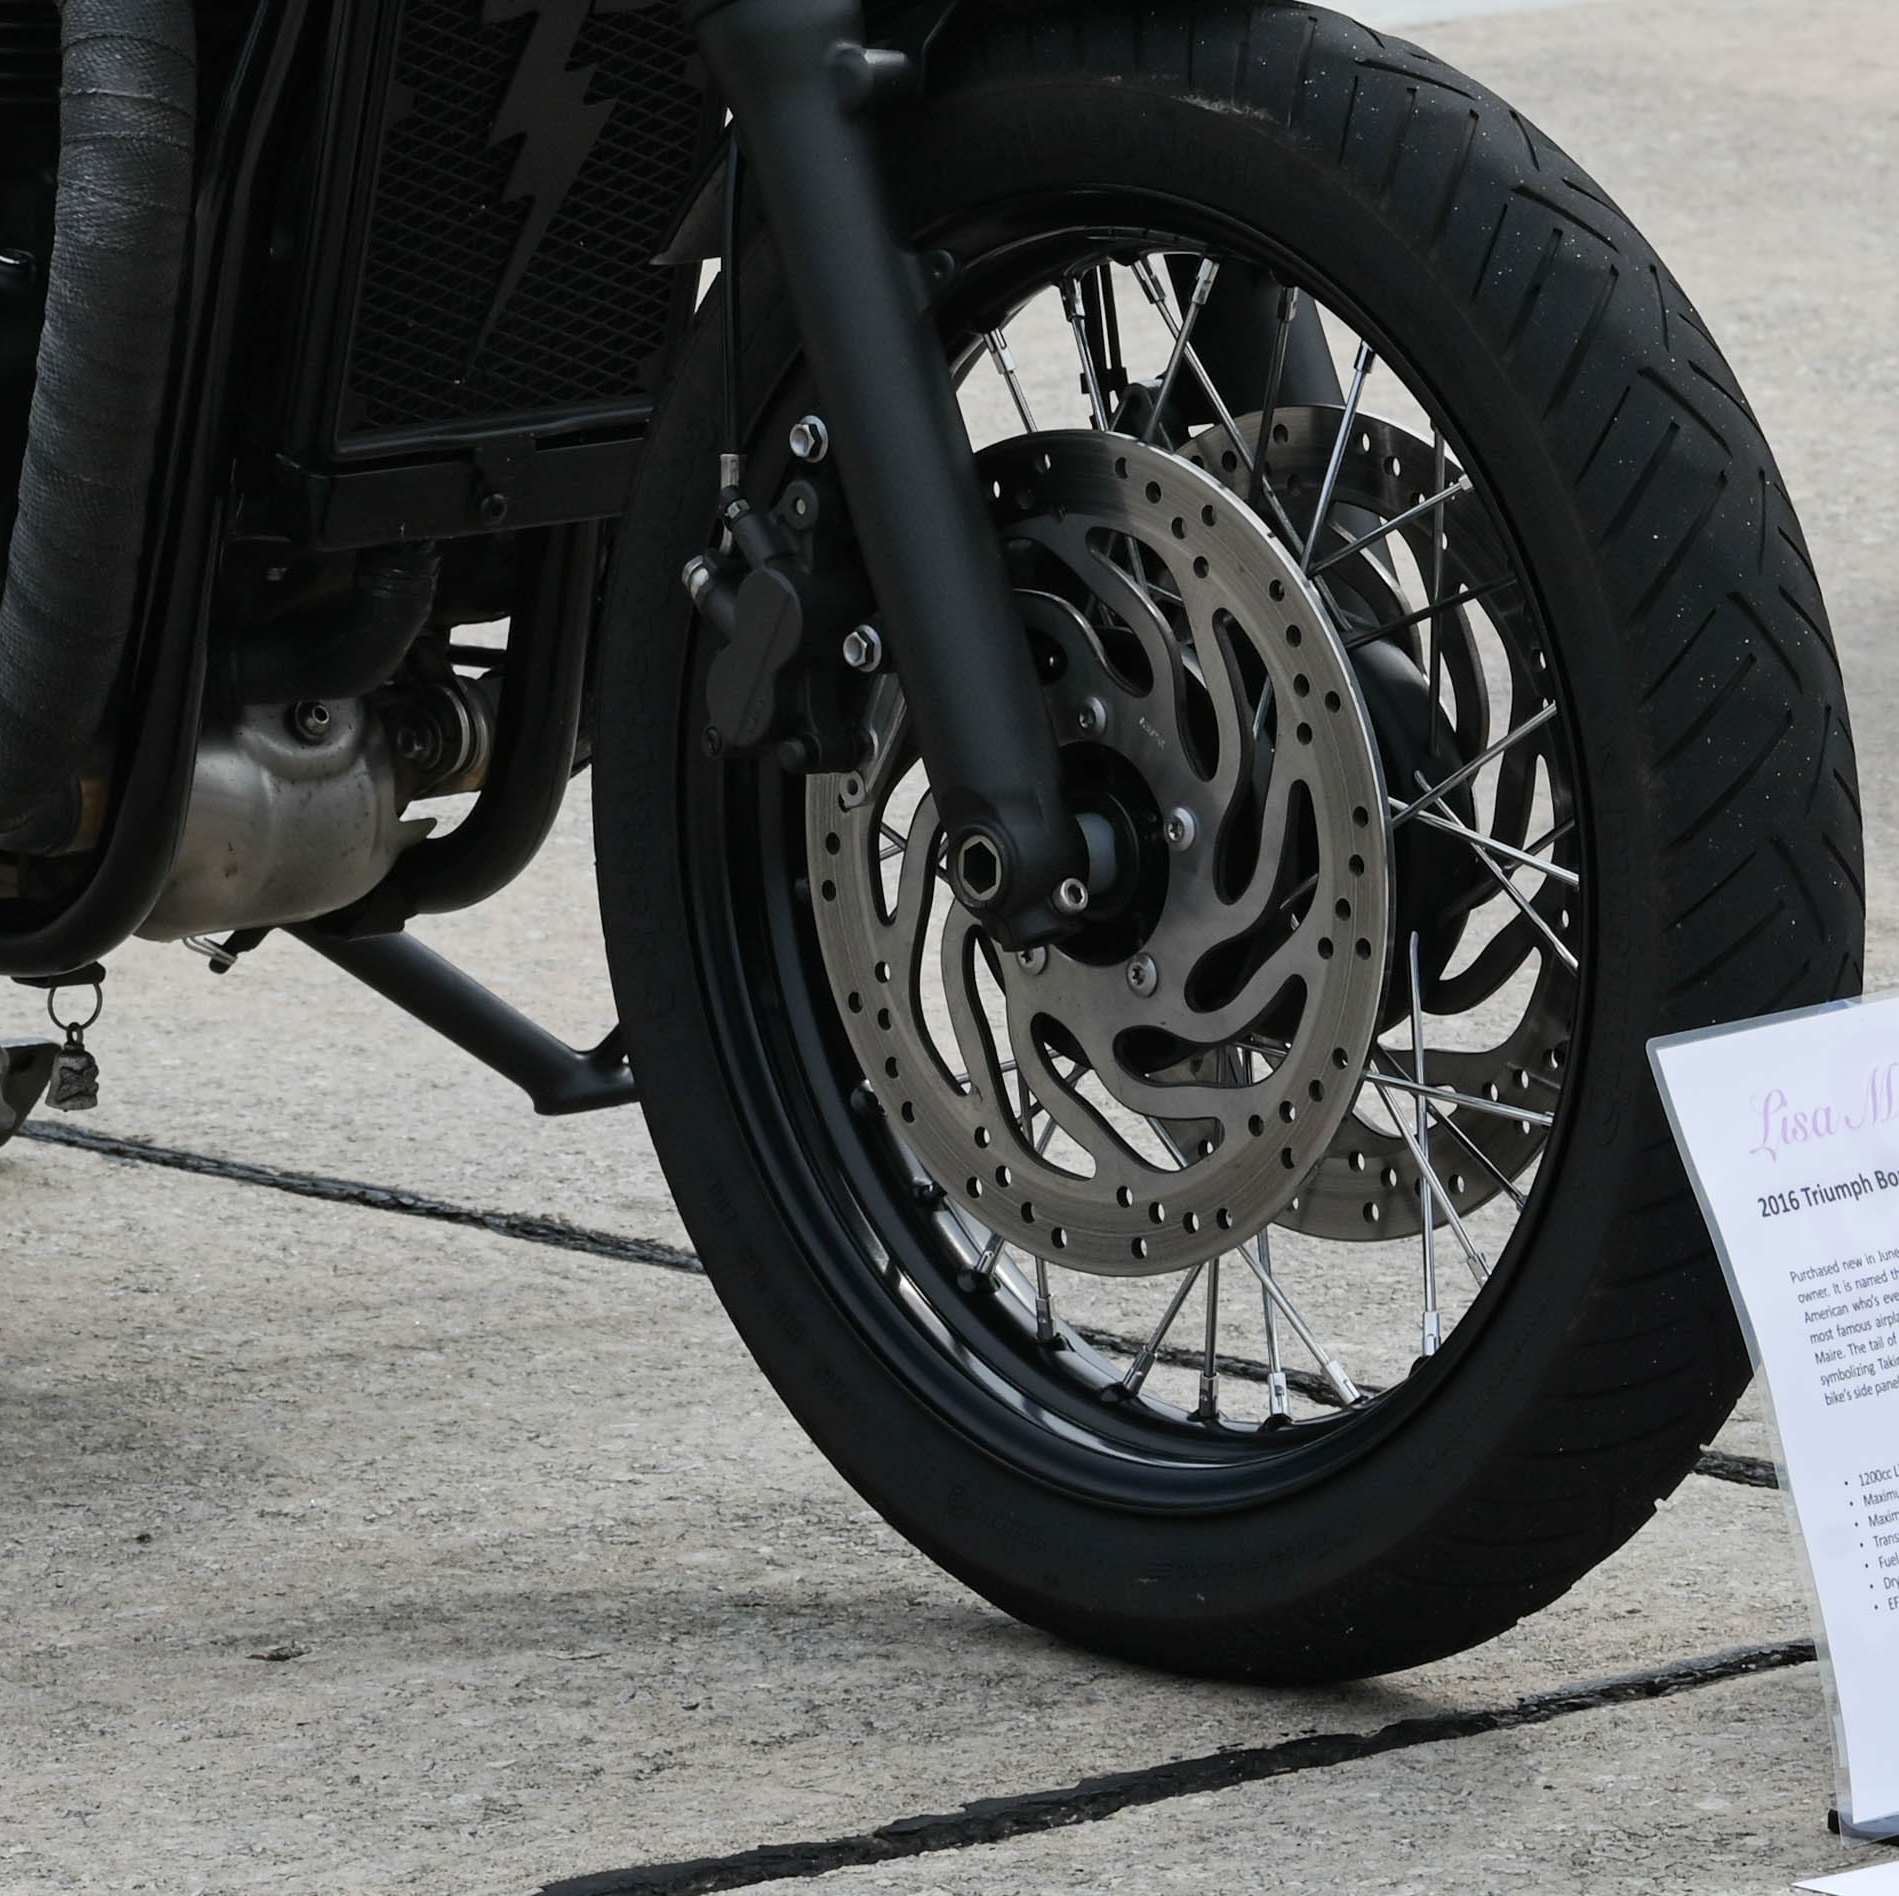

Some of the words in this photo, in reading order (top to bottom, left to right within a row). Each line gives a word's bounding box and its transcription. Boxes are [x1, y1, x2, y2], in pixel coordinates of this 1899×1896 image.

[1748, 1088, 1840, 1165] Lisa
[1757, 1189, 1800, 1217] 2016
[1799, 1172, 1873, 1207] Triumph
[1788, 1259, 1840, 1283] Purchased
[1841, 1257, 1863, 1271] new
[1864, 1253, 1876, 1265] in
[1877, 1247, 1899, 1262] June
[1797, 1287, 1830, 1304] owner.
[1831, 1282, 1841, 1294] It
[1841, 1279, 1853, 1292] is
[1854, 1269, 1888, 1289] named
[1803, 1303, 1849, 1324] American
[1851, 1293, 1880, 1312] who's
[1809, 1327, 1834, 1344] most
[1835, 1319, 1872, 1337] famous
[1813, 1348, 1845, 1365] Maire.
[1846, 1341, 1867, 1356] The
[1867, 1335, 1884, 1351] tail
[1886, 1331, 1897, 1346] of
[1819, 1362, 1876, 1387] symbolizing
[1823, 1387, 1852, 1406] bike's
[1852, 1383, 1873, 1399] side
[1857, 1468, 1892, 1487] 1200cc
[1877, 1551, 1899, 1569] Fuel
[1882, 1576, 1899, 1590] Dry
